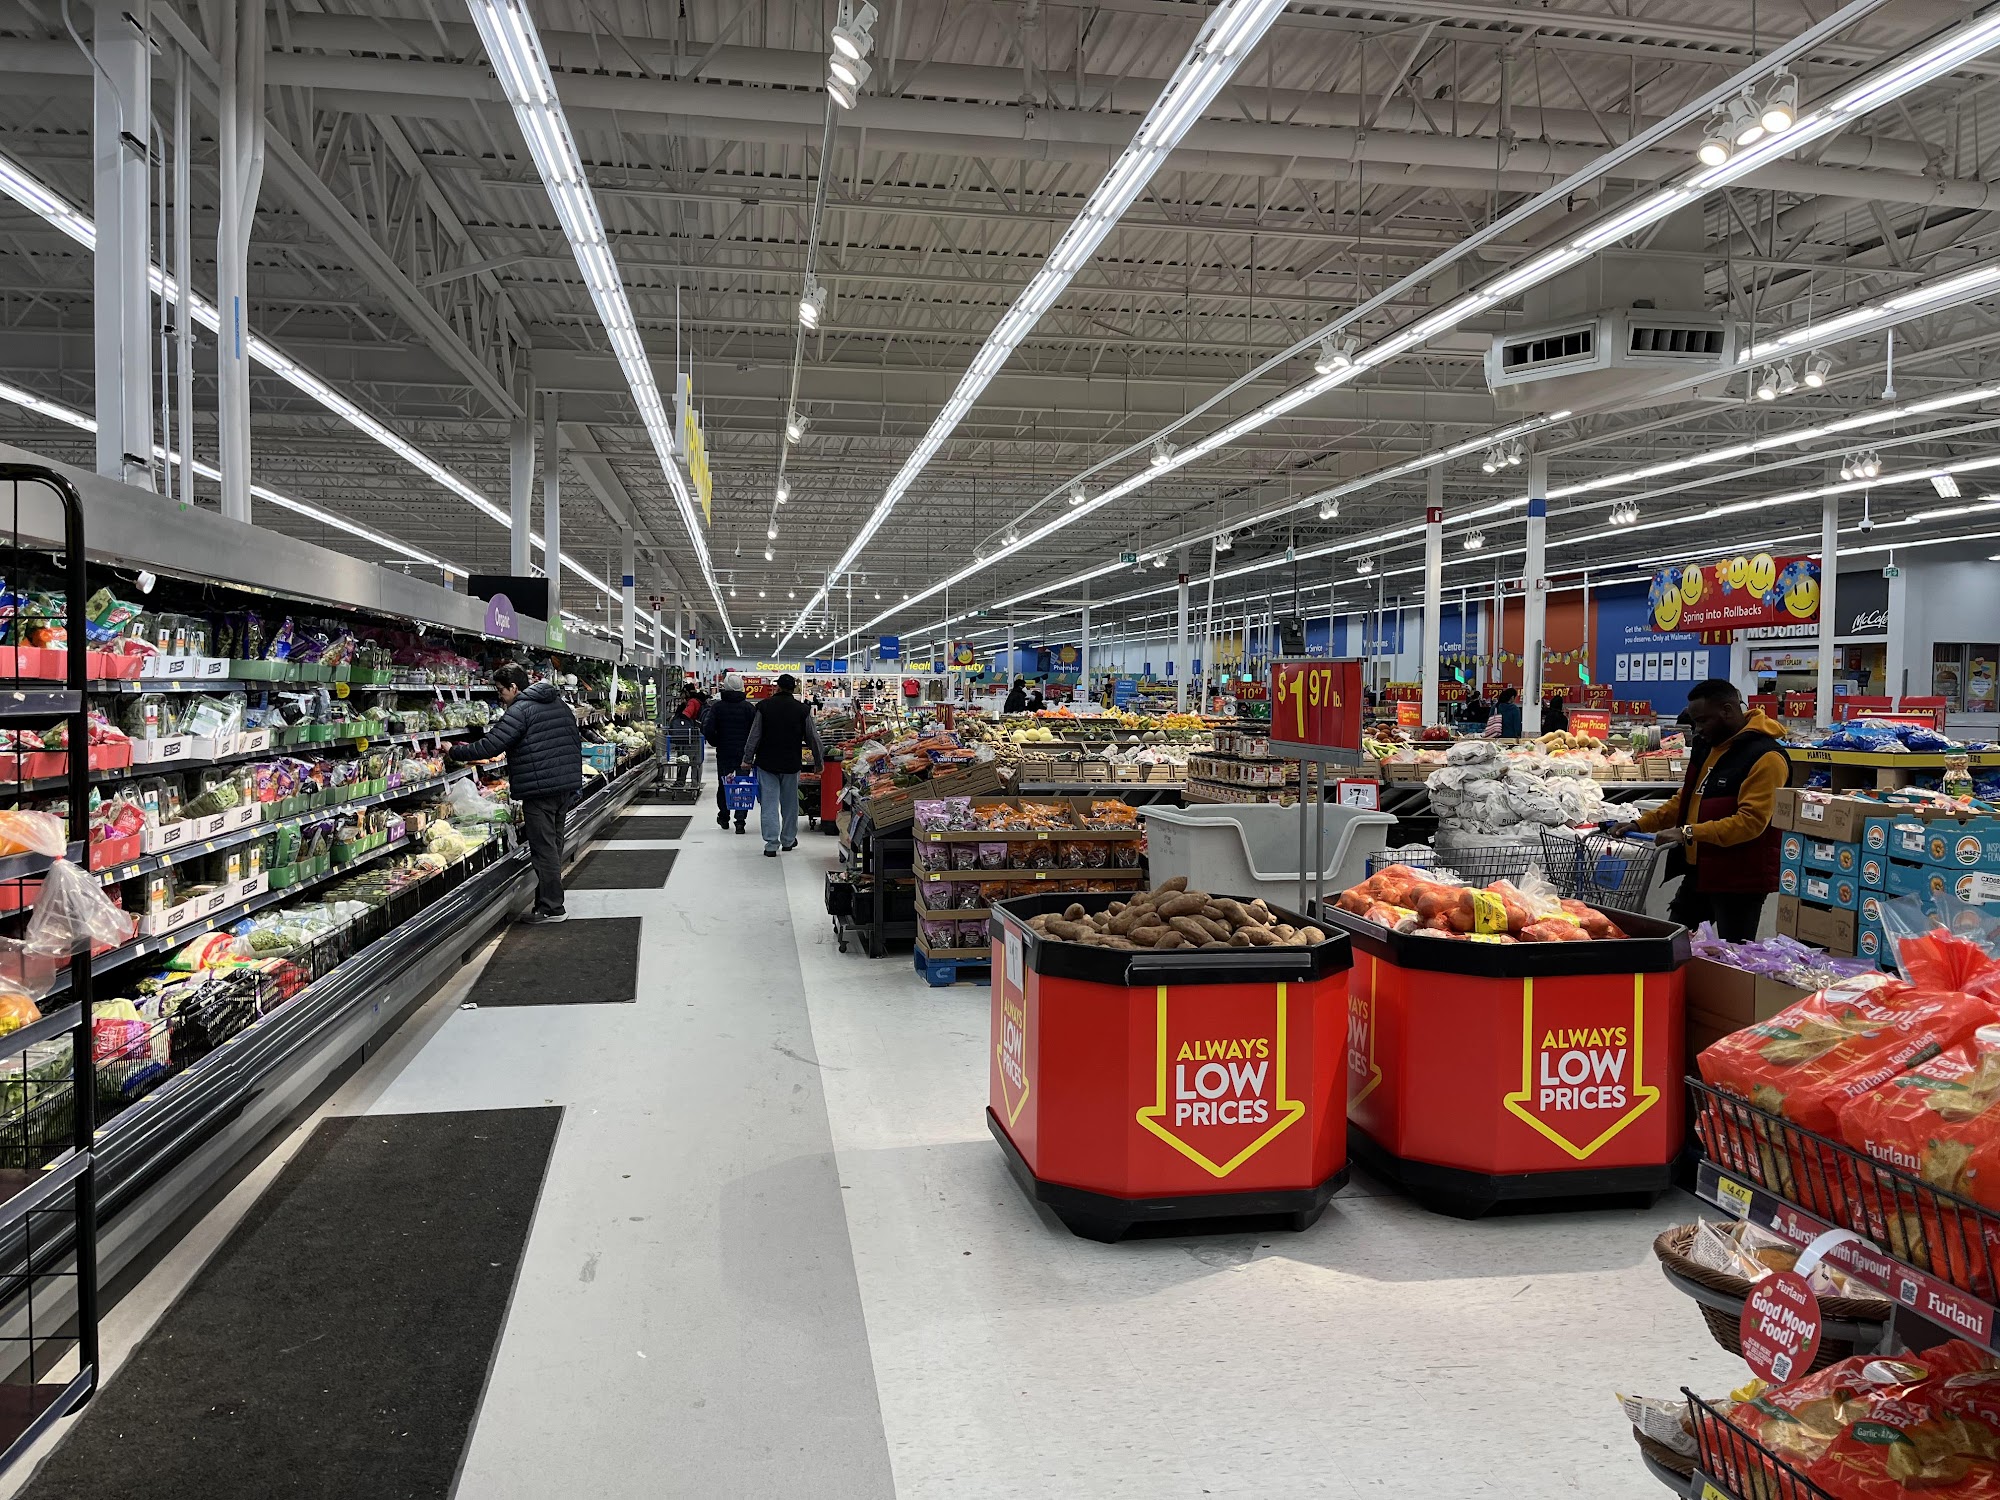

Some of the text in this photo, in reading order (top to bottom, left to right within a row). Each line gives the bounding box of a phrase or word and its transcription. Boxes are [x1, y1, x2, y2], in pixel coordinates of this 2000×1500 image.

[1683, 604, 1762, 624] Spring into Rollbacks
[1624, 625, 1633, 633] Get
[1624, 636, 1633, 645] you
[1633, 635, 1652, 643] deserve.
[1652, 634, 1664, 643] Only
[1664, 634, 1670, 642] at
[1309, 644, 1322, 652] Service
[1443, 641, 1462, 652] Centre
[756, 661, 800, 671] Seasonal
[905, 661, 931, 671] Healt
[1053, 664, 1079, 672] Pharmacy
[1935, 663, 1960, 673] Whoa
[1333, 691, 1343, 708] lb.
[1577, 719, 1606, 730] Low Prices
[1807, 751, 1832, 761] PLANTERS
[1004, 997, 1022, 1029] ALWAYS
[1004, 1015, 1022, 1064] LOW
[1176, 1038, 1269, 1062] ALWAYS
[1540, 1027, 1627, 1049] ALWAYS
[1888, 1031, 1938, 1066] Texas Toast
[1003, 1048, 1022, 1089] PRICES
[1540, 1049, 1627, 1086] LOW
[1175, 1061, 1269, 1100] LOW
[1843, 1066, 1896, 1098] Furlani
[1540, 1086, 1627, 1112] PRICES
[1175, 1099, 1269, 1127] PRICES
[1865, 1139, 1922, 1171] Furlani
[1788, 1222, 1820, 1245] Bursti
[1829, 1243, 1850, 1263] with
[1852, 1247, 1891, 1280] flavour!
[1776, 1279, 1807, 1305] Furlani
[1751, 1291, 1816, 1340] Good Mood
[1928, 1292, 1984, 1335] Furlani
[1759, 1315, 1795, 1348] Food!
[1857, 1427, 1877, 1439] Garlic
